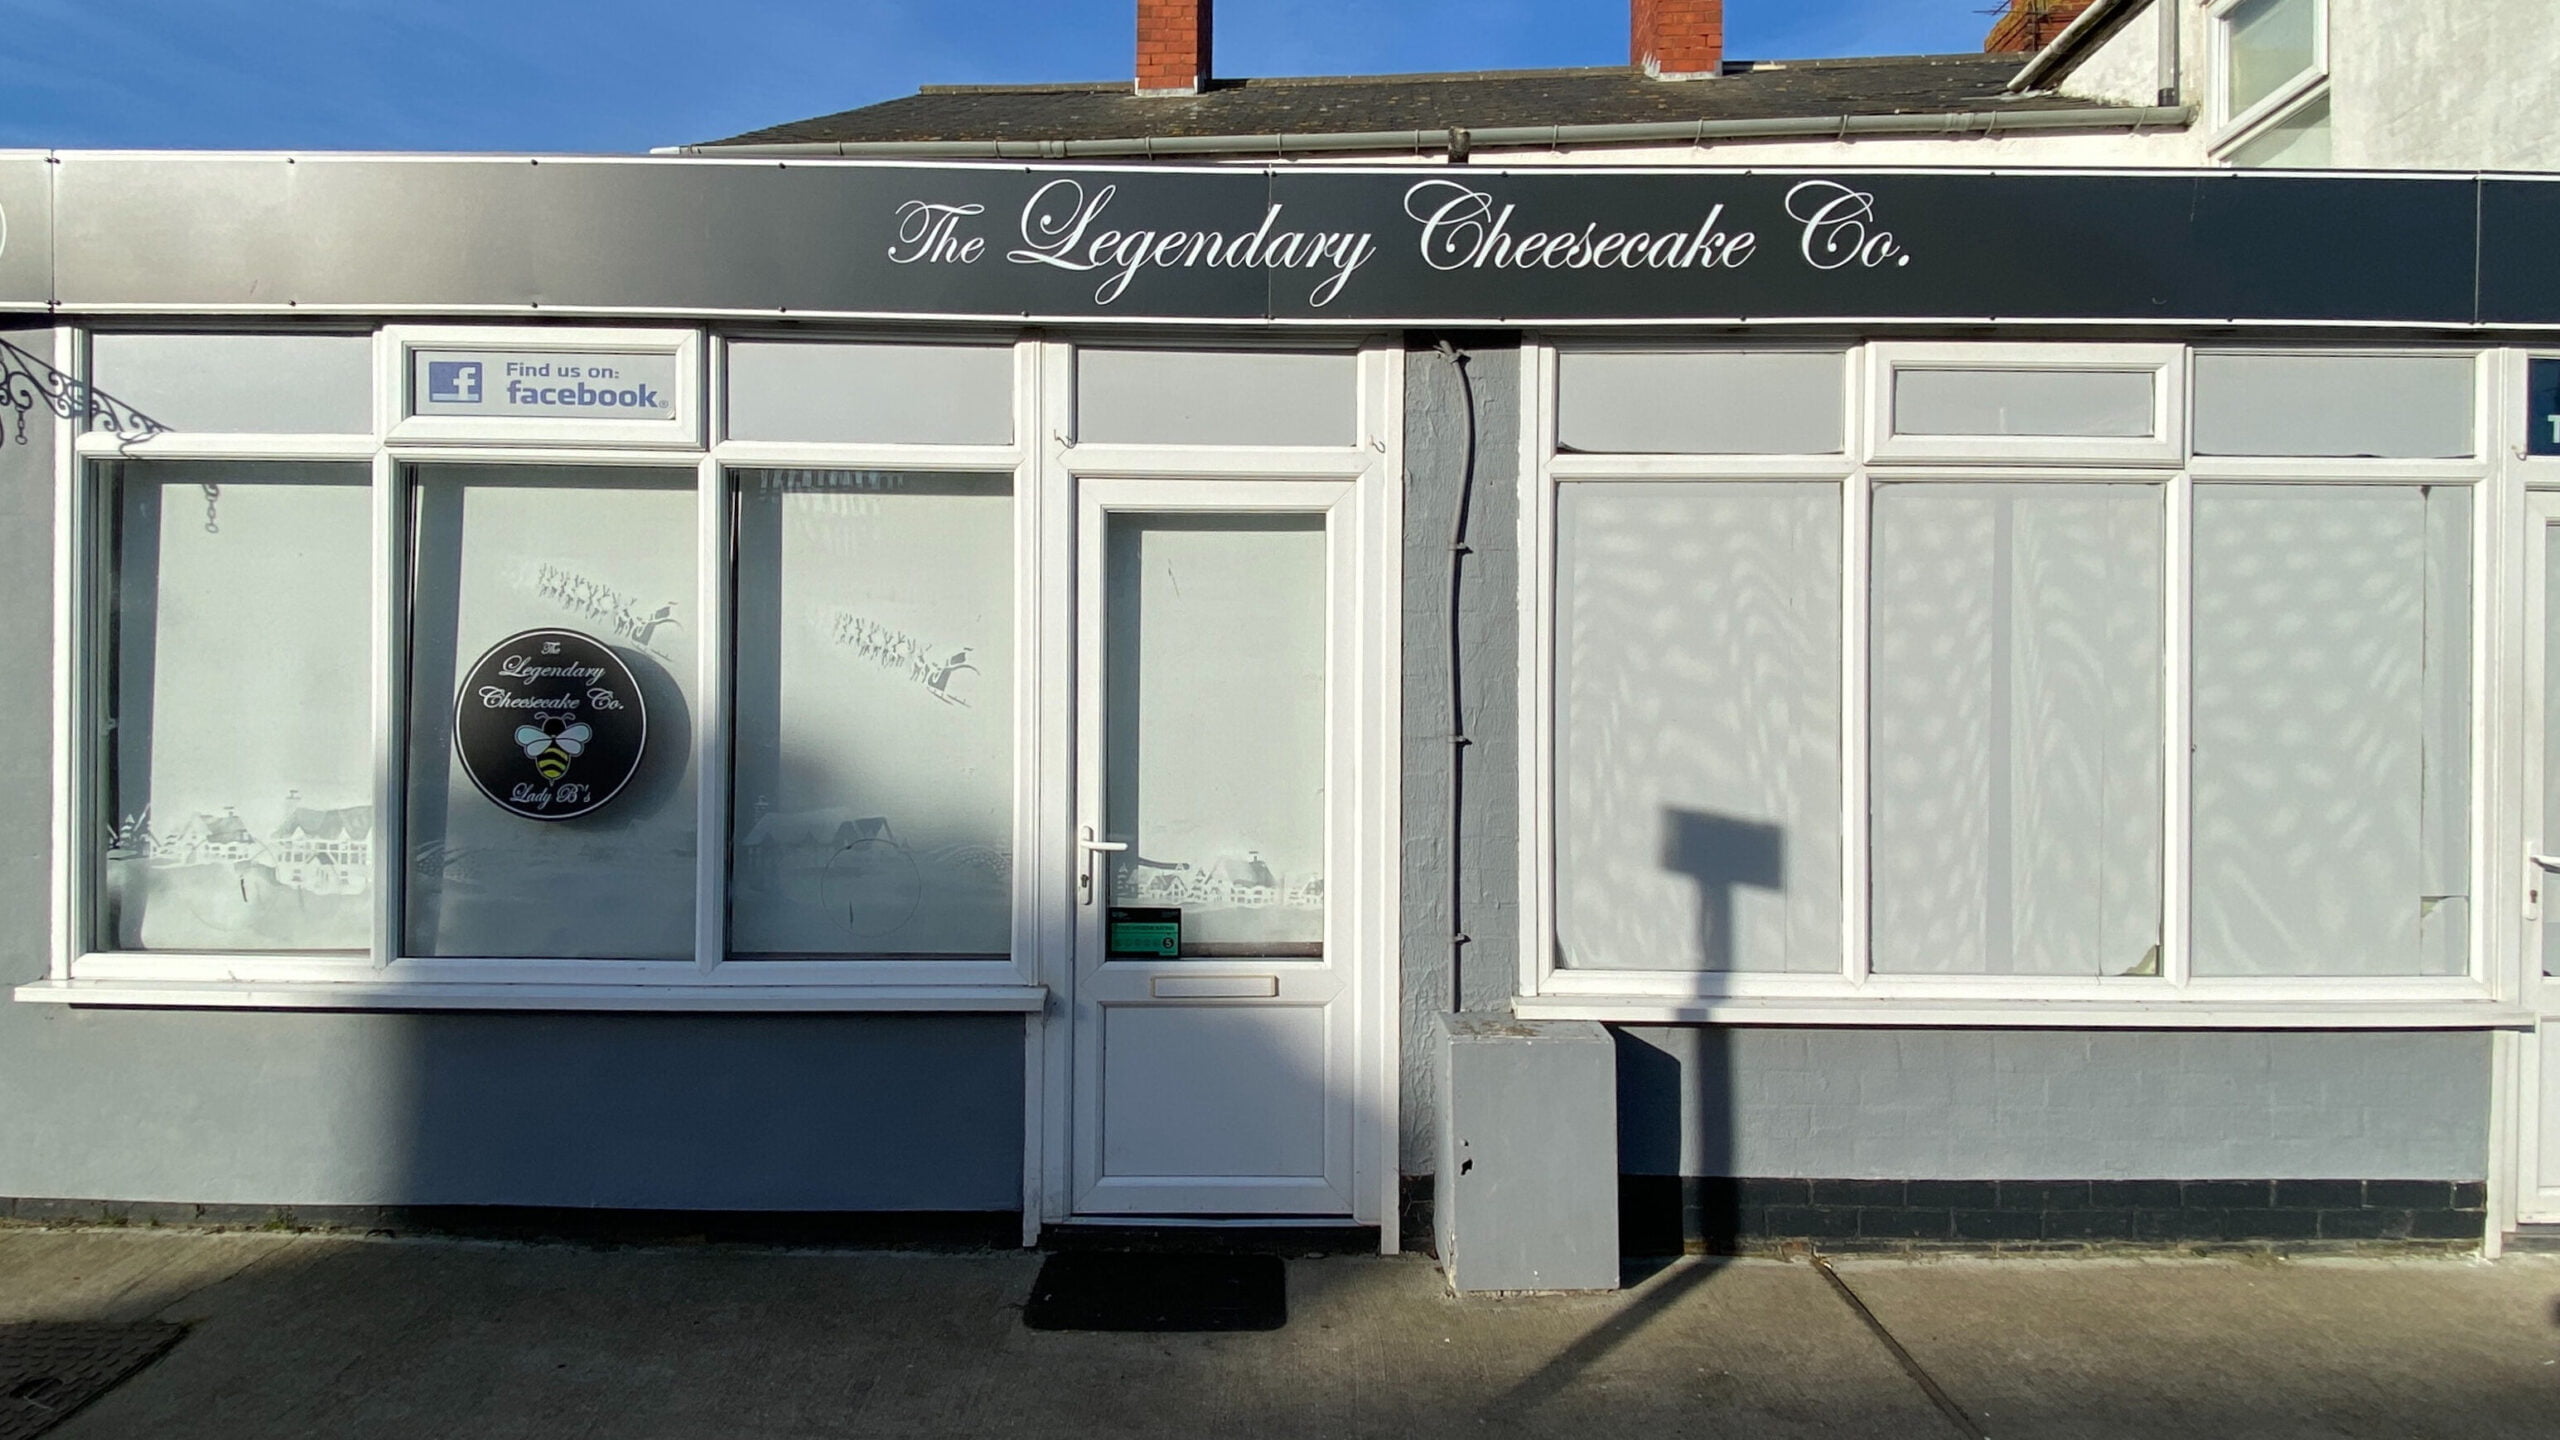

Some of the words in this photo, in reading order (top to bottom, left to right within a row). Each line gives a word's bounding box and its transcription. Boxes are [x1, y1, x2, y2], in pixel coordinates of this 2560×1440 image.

[887, 200, 986, 264] The
[1006, 178, 1377, 308] Legendary
[1403, 178, 1756, 271] Cheesecake
[1784, 179, 1911, 271] Co.
[506, 362, 551, 378] Find
[557, 366, 581, 378] us
[588, 366, 620, 379] on:
[507, 380, 658, 408] facebook
[541, 641, 561, 655] The
[498, 655, 606, 686] Legendary
[478, 685, 581, 709] Cheesecake
[587, 687, 625, 711] Co.
[510, 782, 552, 810] Lady
[556, 783, 591, 804] B's
